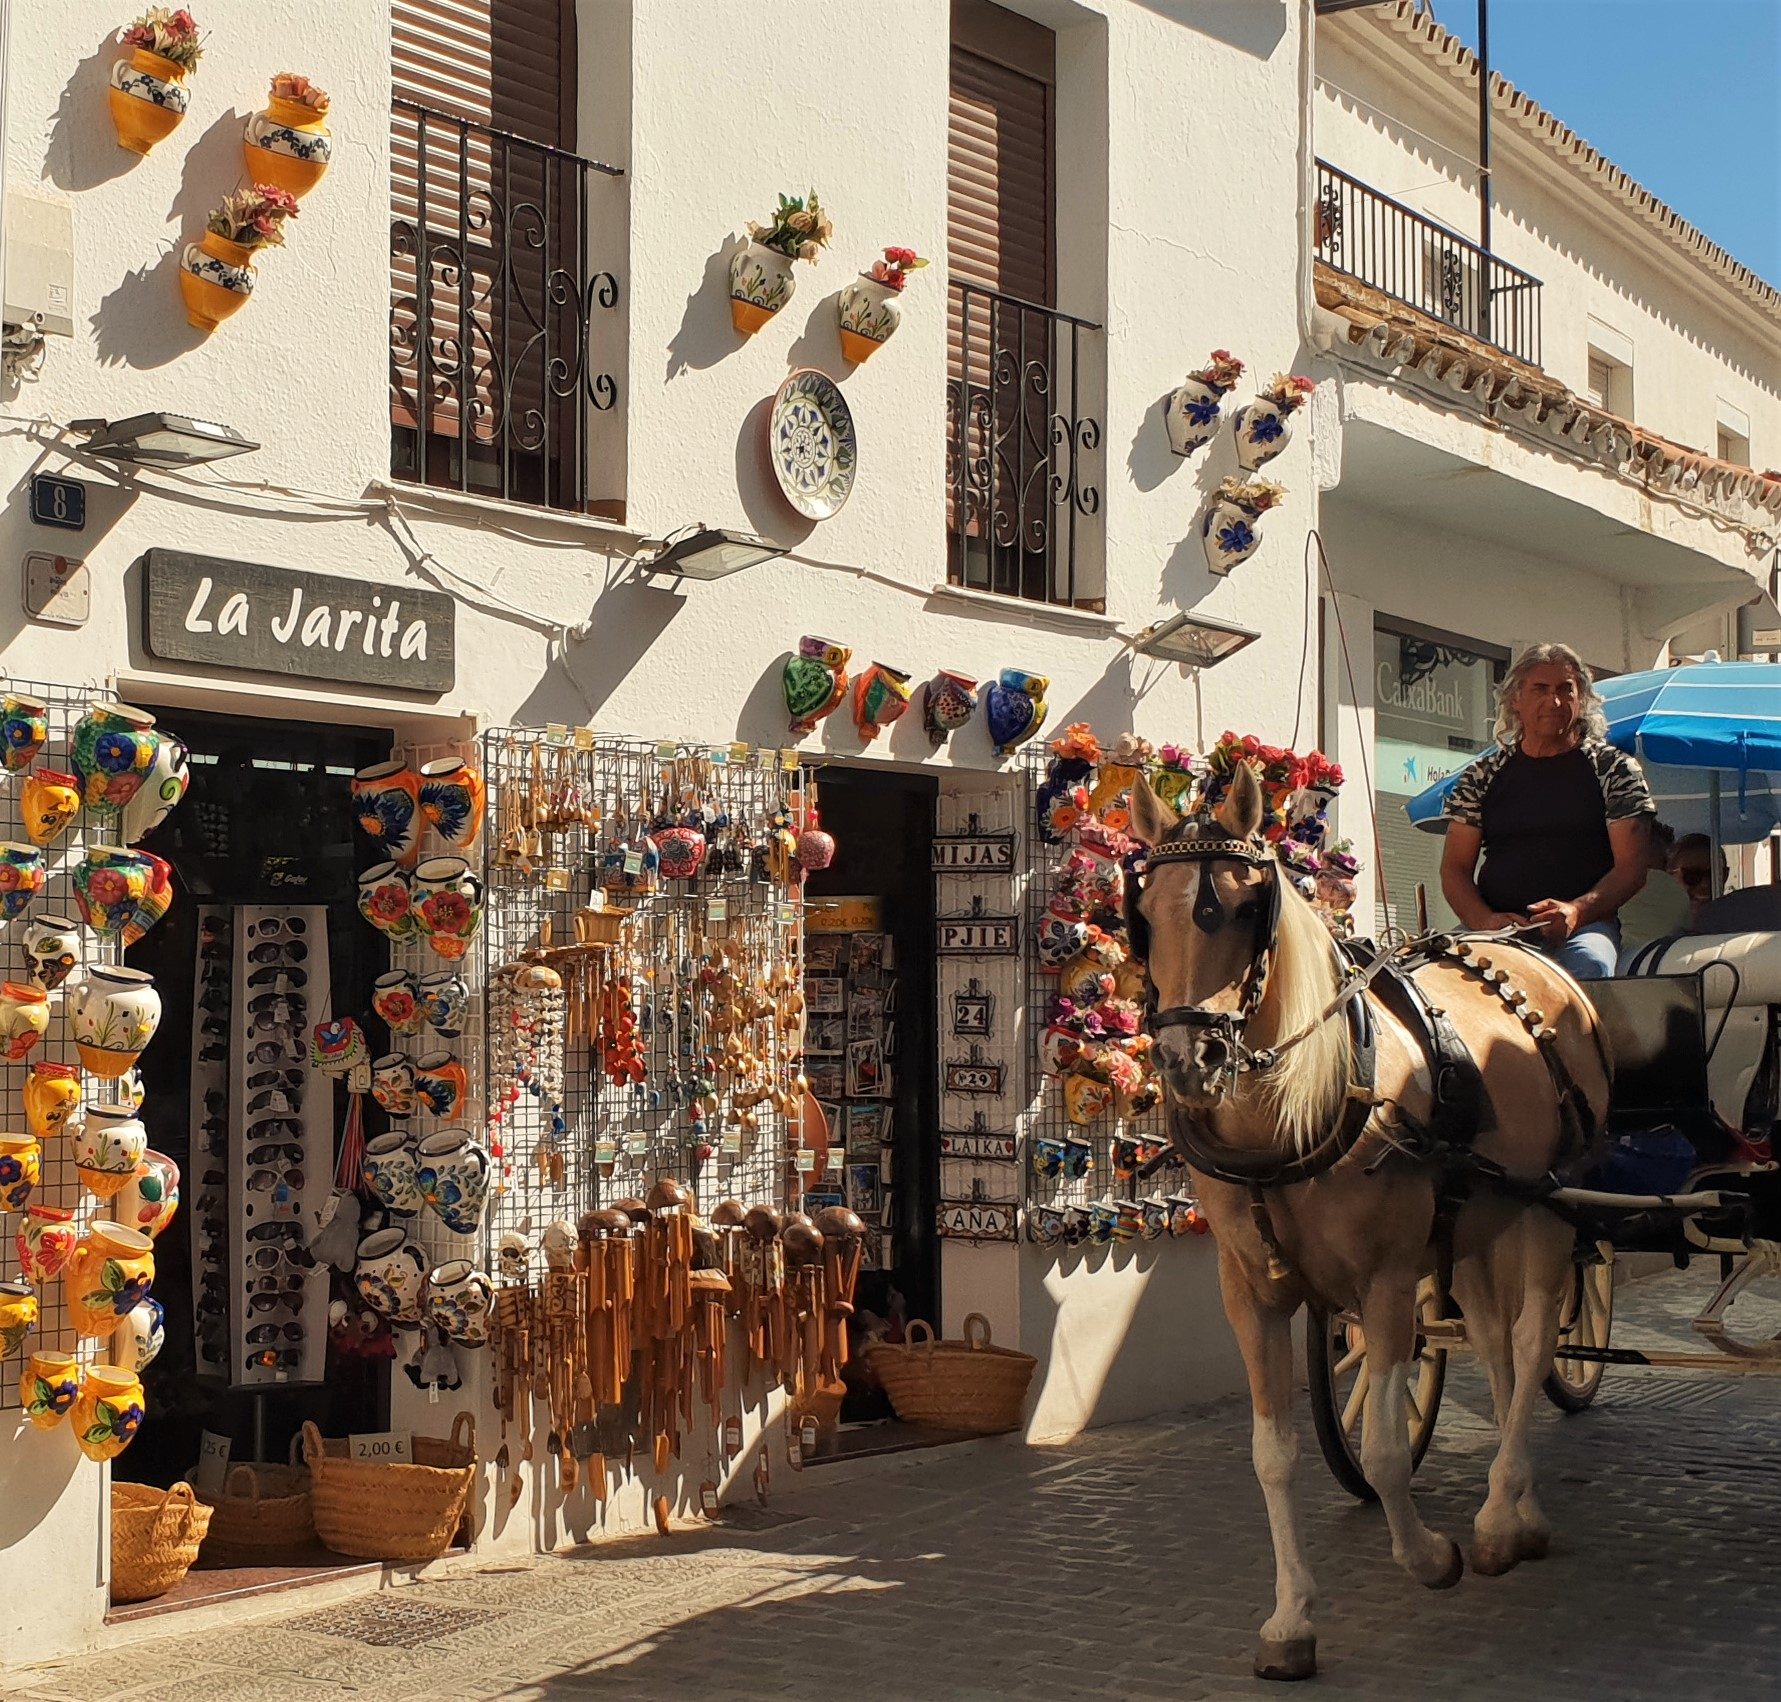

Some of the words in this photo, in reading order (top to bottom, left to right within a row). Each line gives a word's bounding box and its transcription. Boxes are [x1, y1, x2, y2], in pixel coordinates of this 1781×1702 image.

[54, 485, 67, 519] 8
[185, 577, 249, 636] La
[271, 588, 427, 661] Jarita
[1377, 662, 1464, 720] CaixaBank
[932, 845, 1010, 864] MIJAS
[944, 928, 1007, 946] PJIE
[957, 1006, 985, 1025] 24
[951, 1139, 1003, 1155] LAIKA
[953, 1210, 998, 1229] ANA
[358, 1441, 390, 1458] 2,00
